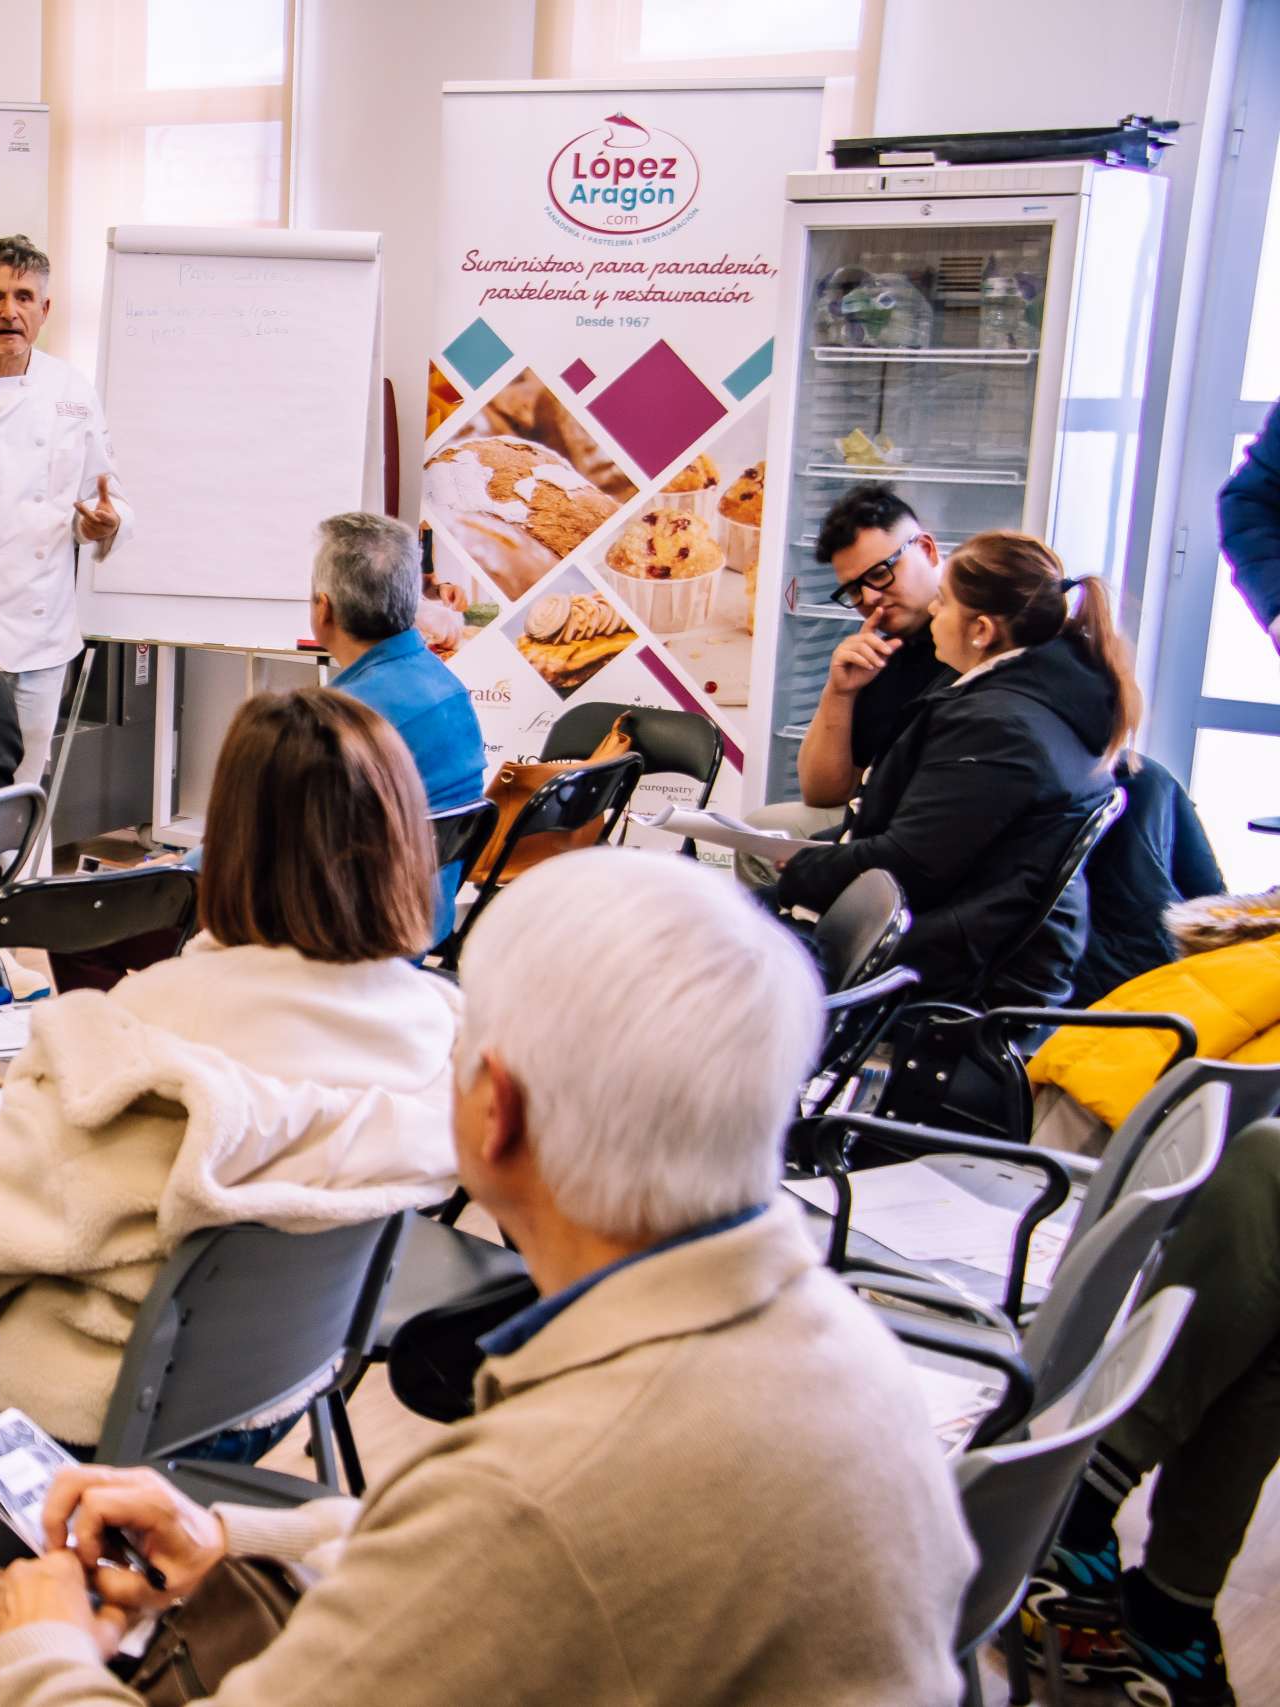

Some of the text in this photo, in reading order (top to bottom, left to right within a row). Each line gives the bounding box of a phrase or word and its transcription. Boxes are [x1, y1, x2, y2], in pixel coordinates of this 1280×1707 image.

[573, 151, 677, 185] López
[569, 181, 674, 212] Aragón
[603, 215, 638, 225] .com
[461, 249, 778, 281] Suministros para panadería,
[478, 280, 754, 310] pastelería y restauración
[575, 316, 650, 328] Desde 1967
[638, 785, 695, 796] europastry
